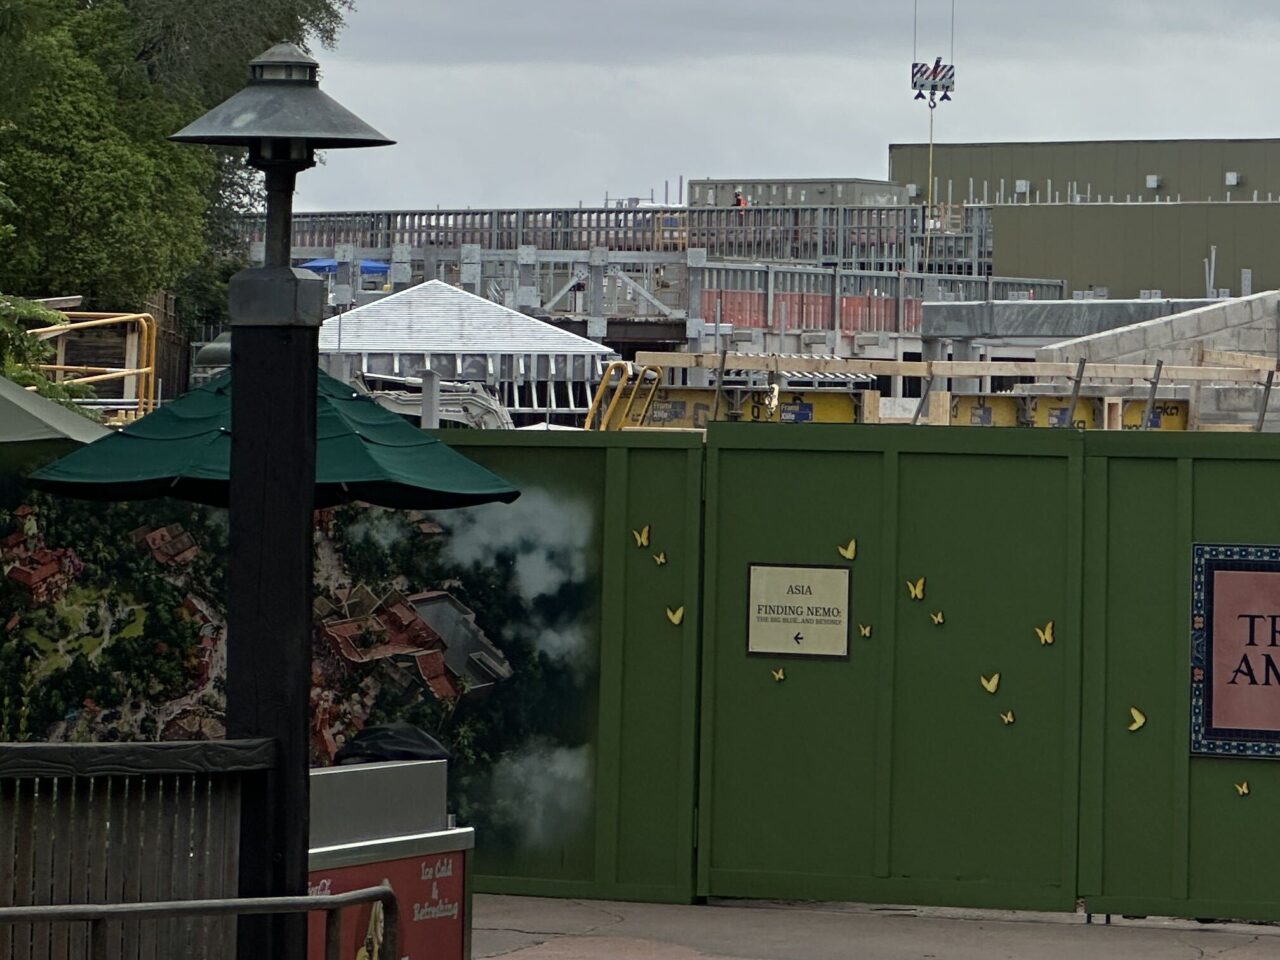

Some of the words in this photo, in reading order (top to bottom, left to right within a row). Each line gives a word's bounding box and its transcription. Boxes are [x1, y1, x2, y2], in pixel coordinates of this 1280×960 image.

[786, 585, 812, 595] ASIA
[757, 605, 803, 615] FINDING
[807, 606, 842, 617] NEMO:
[421, 861, 433, 880] Ice
[435, 858, 453, 879] Cold
[413, 899, 459, 921] Refreshing
